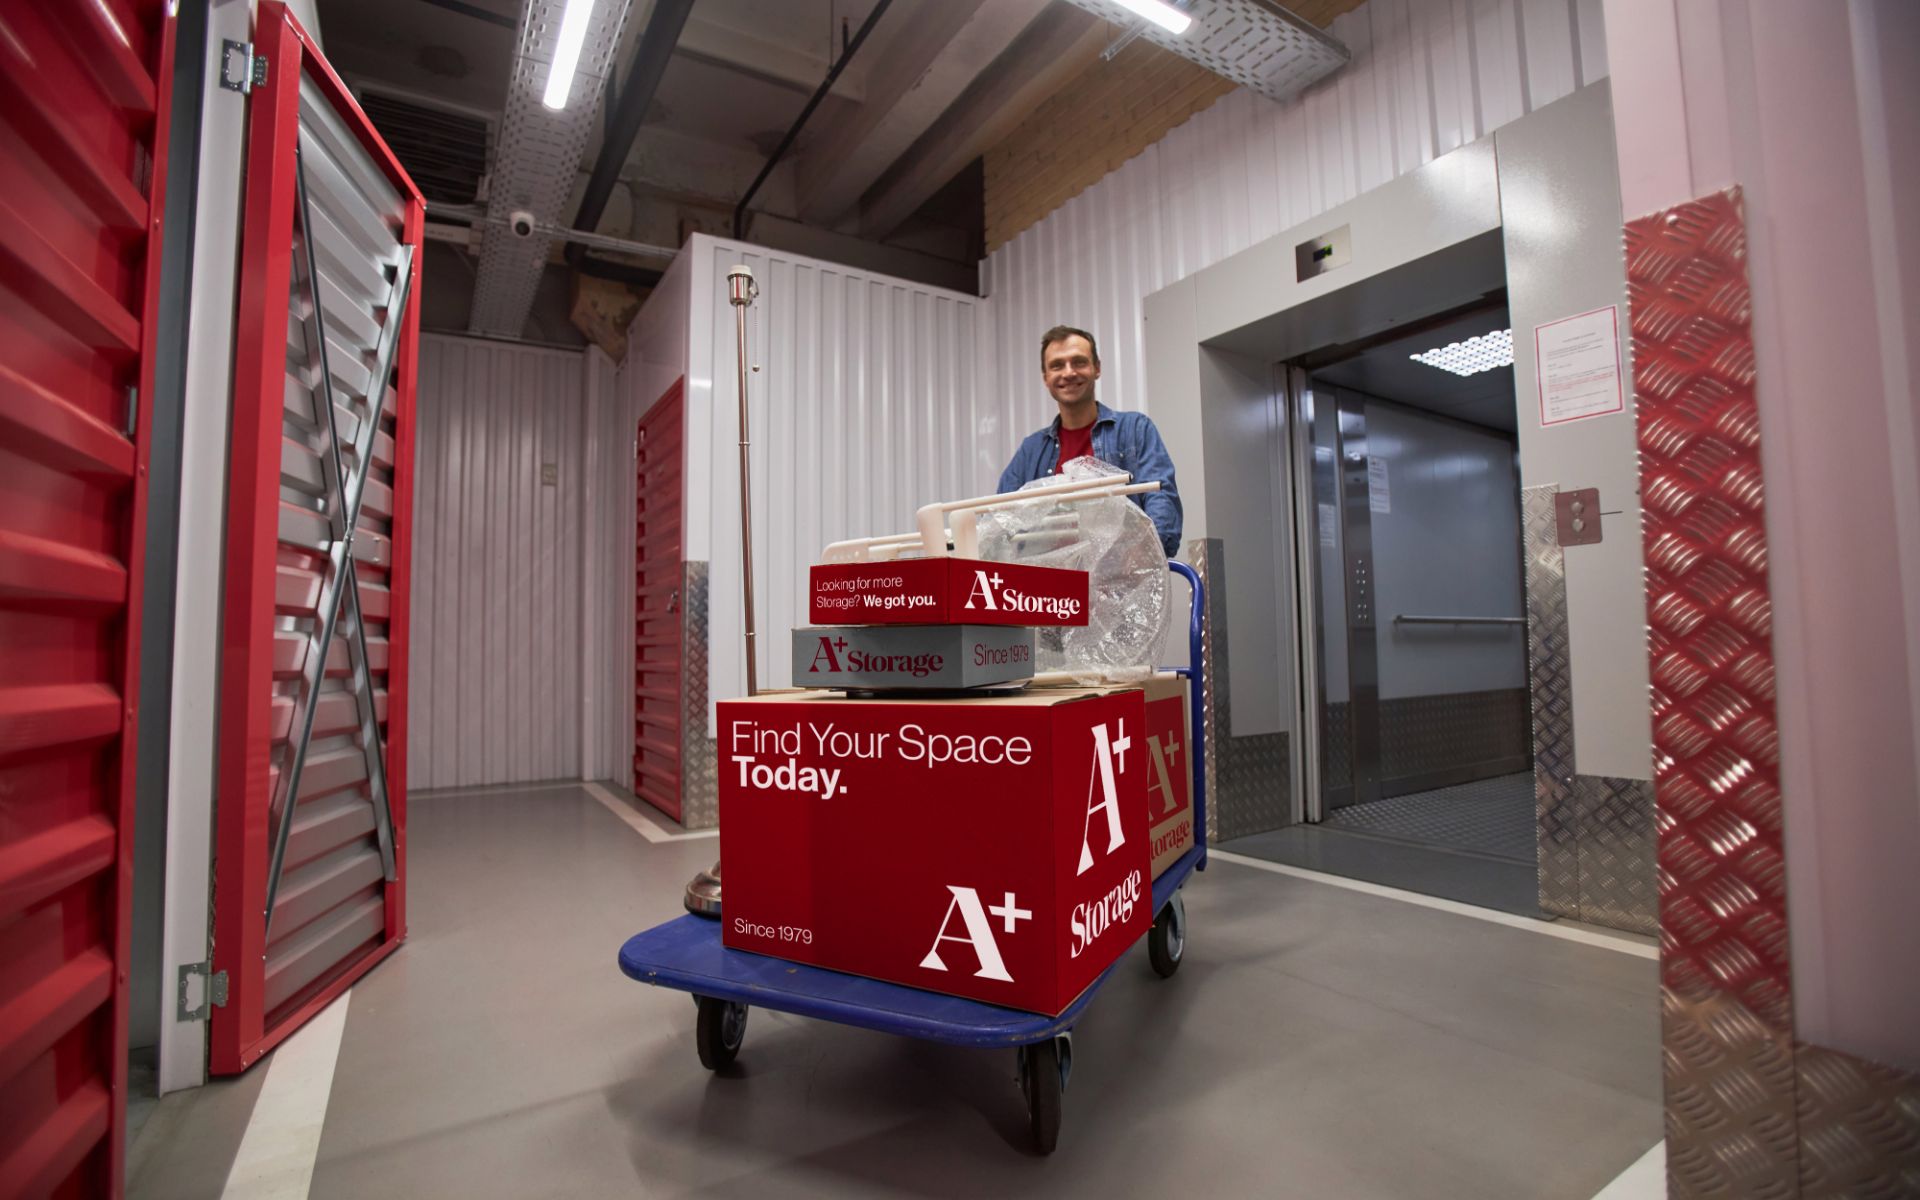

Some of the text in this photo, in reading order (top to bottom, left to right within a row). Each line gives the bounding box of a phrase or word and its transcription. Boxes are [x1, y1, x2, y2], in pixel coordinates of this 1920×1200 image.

[816, 576, 903, 592] Looking for more
[816, 594, 937, 609] Storage? We got you.
[1002, 589, 1081, 619] Storage
[847, 650, 944, 677] Storage
[974, 644, 1029, 666] Since 1979
[732, 720, 1032, 768] Find Your Space
[731, 755, 848, 800] Today.
[1150, 819, 1190, 861] torage
[1070, 869, 1142, 959] Storage
[734, 917, 813, 945] Since 1979
